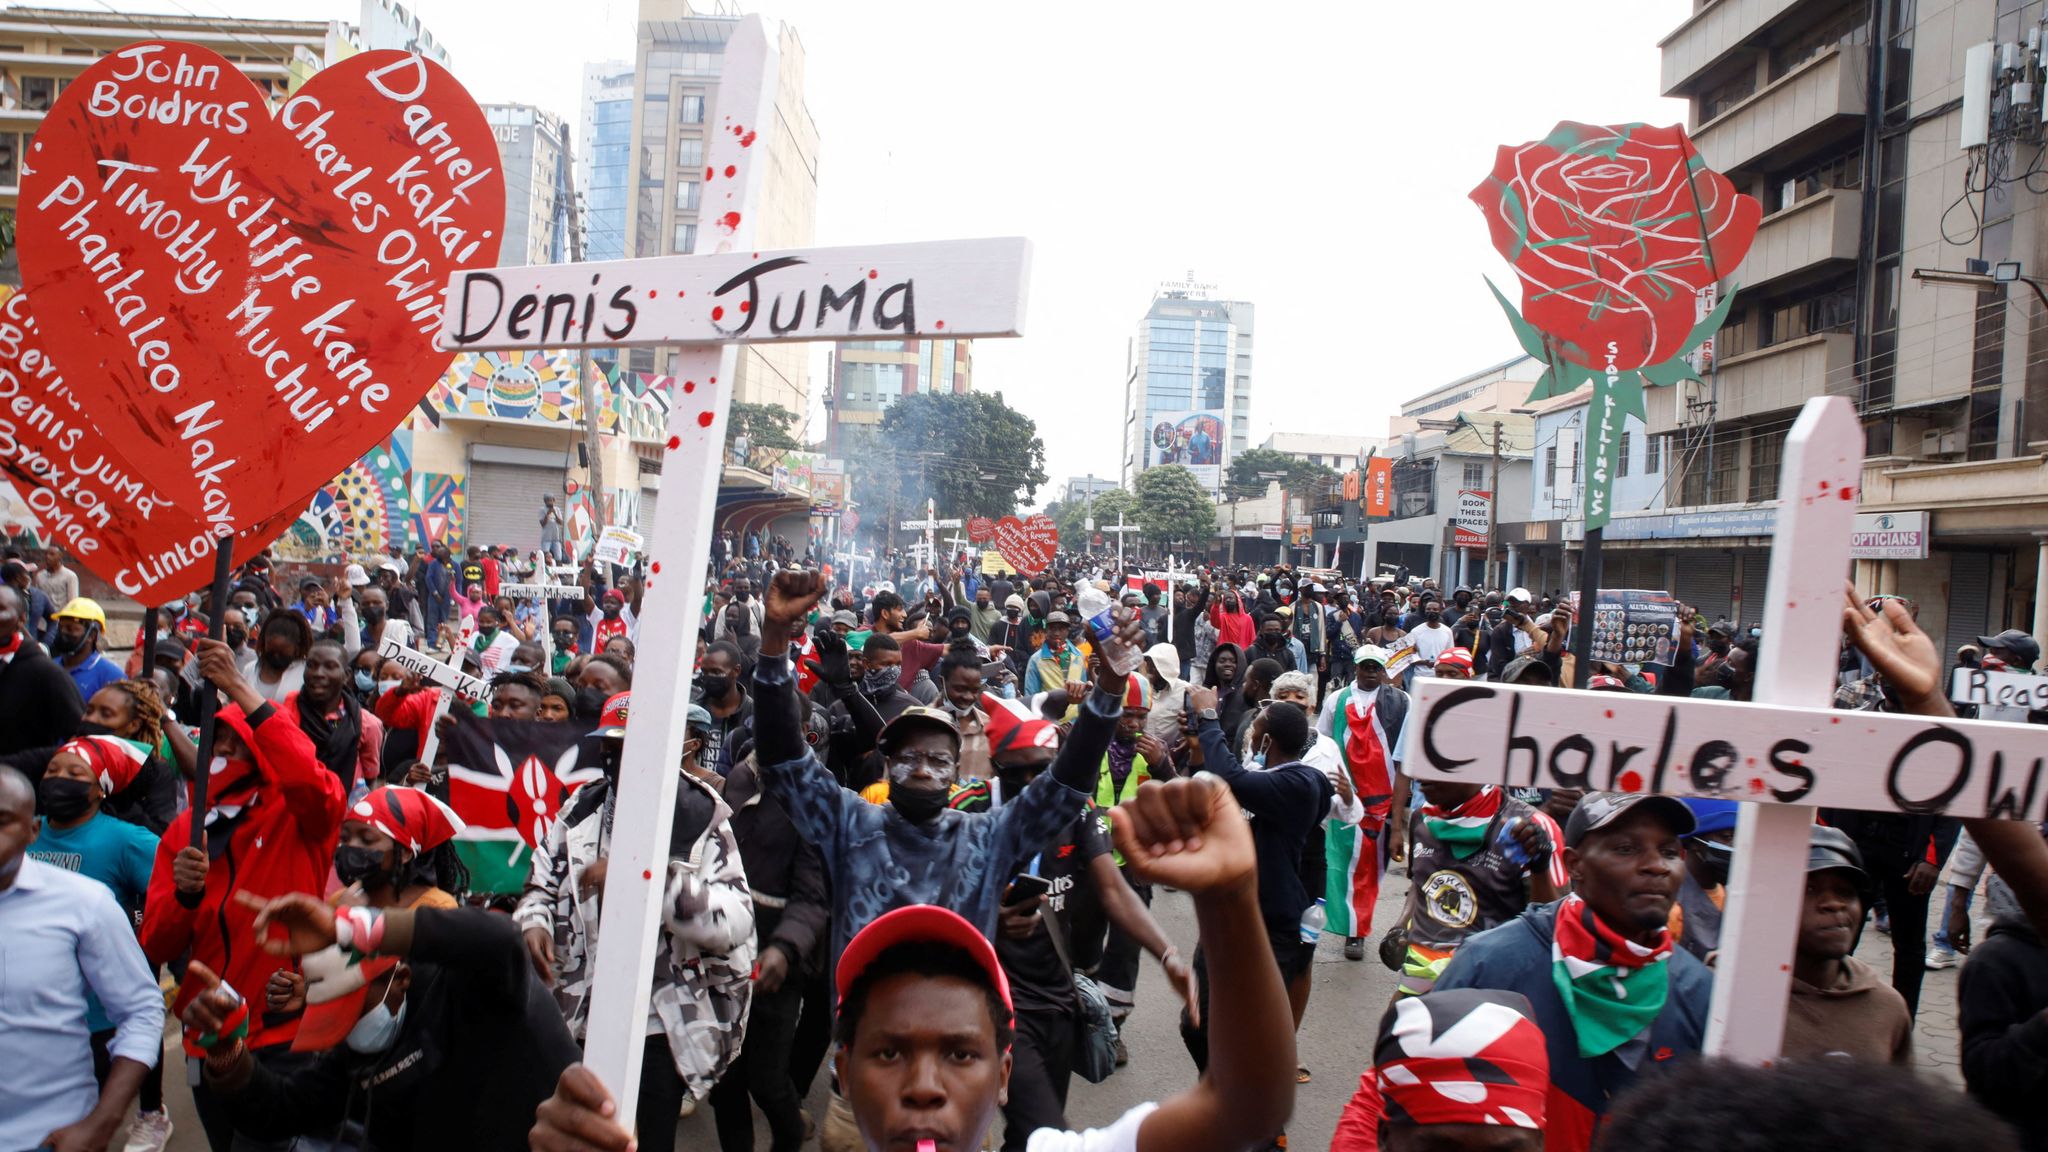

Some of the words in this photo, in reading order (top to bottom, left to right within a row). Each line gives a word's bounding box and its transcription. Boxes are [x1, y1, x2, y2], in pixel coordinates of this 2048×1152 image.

[113, 45, 220, 90] John
[366, 53, 493, 206] Daniel
[281, 95, 390, 233] Charles
[387, 155, 493, 263] Kakai
[180, 137, 321, 300] Wycliffe
[301, 299, 390, 413] Kane
[452, 272, 637, 344] Denis
[712, 256, 917, 337] Juma
[1604, 341, 1619, 389] STOP
[0, 368, 83, 452] Denis
[1456, 518, 1489, 526] SPACES
[1460, 509, 1487, 517] THESE
[1591, 489, 1604, 516] US
[1852, 532, 1918, 546] OPTICIANS
[1887, 548, 1917, 556] EYECARE
[384, 642, 438, 678] Daniel
[1421, 685, 1815, 803] Charles
[1886, 722, 2048, 821] Ow
